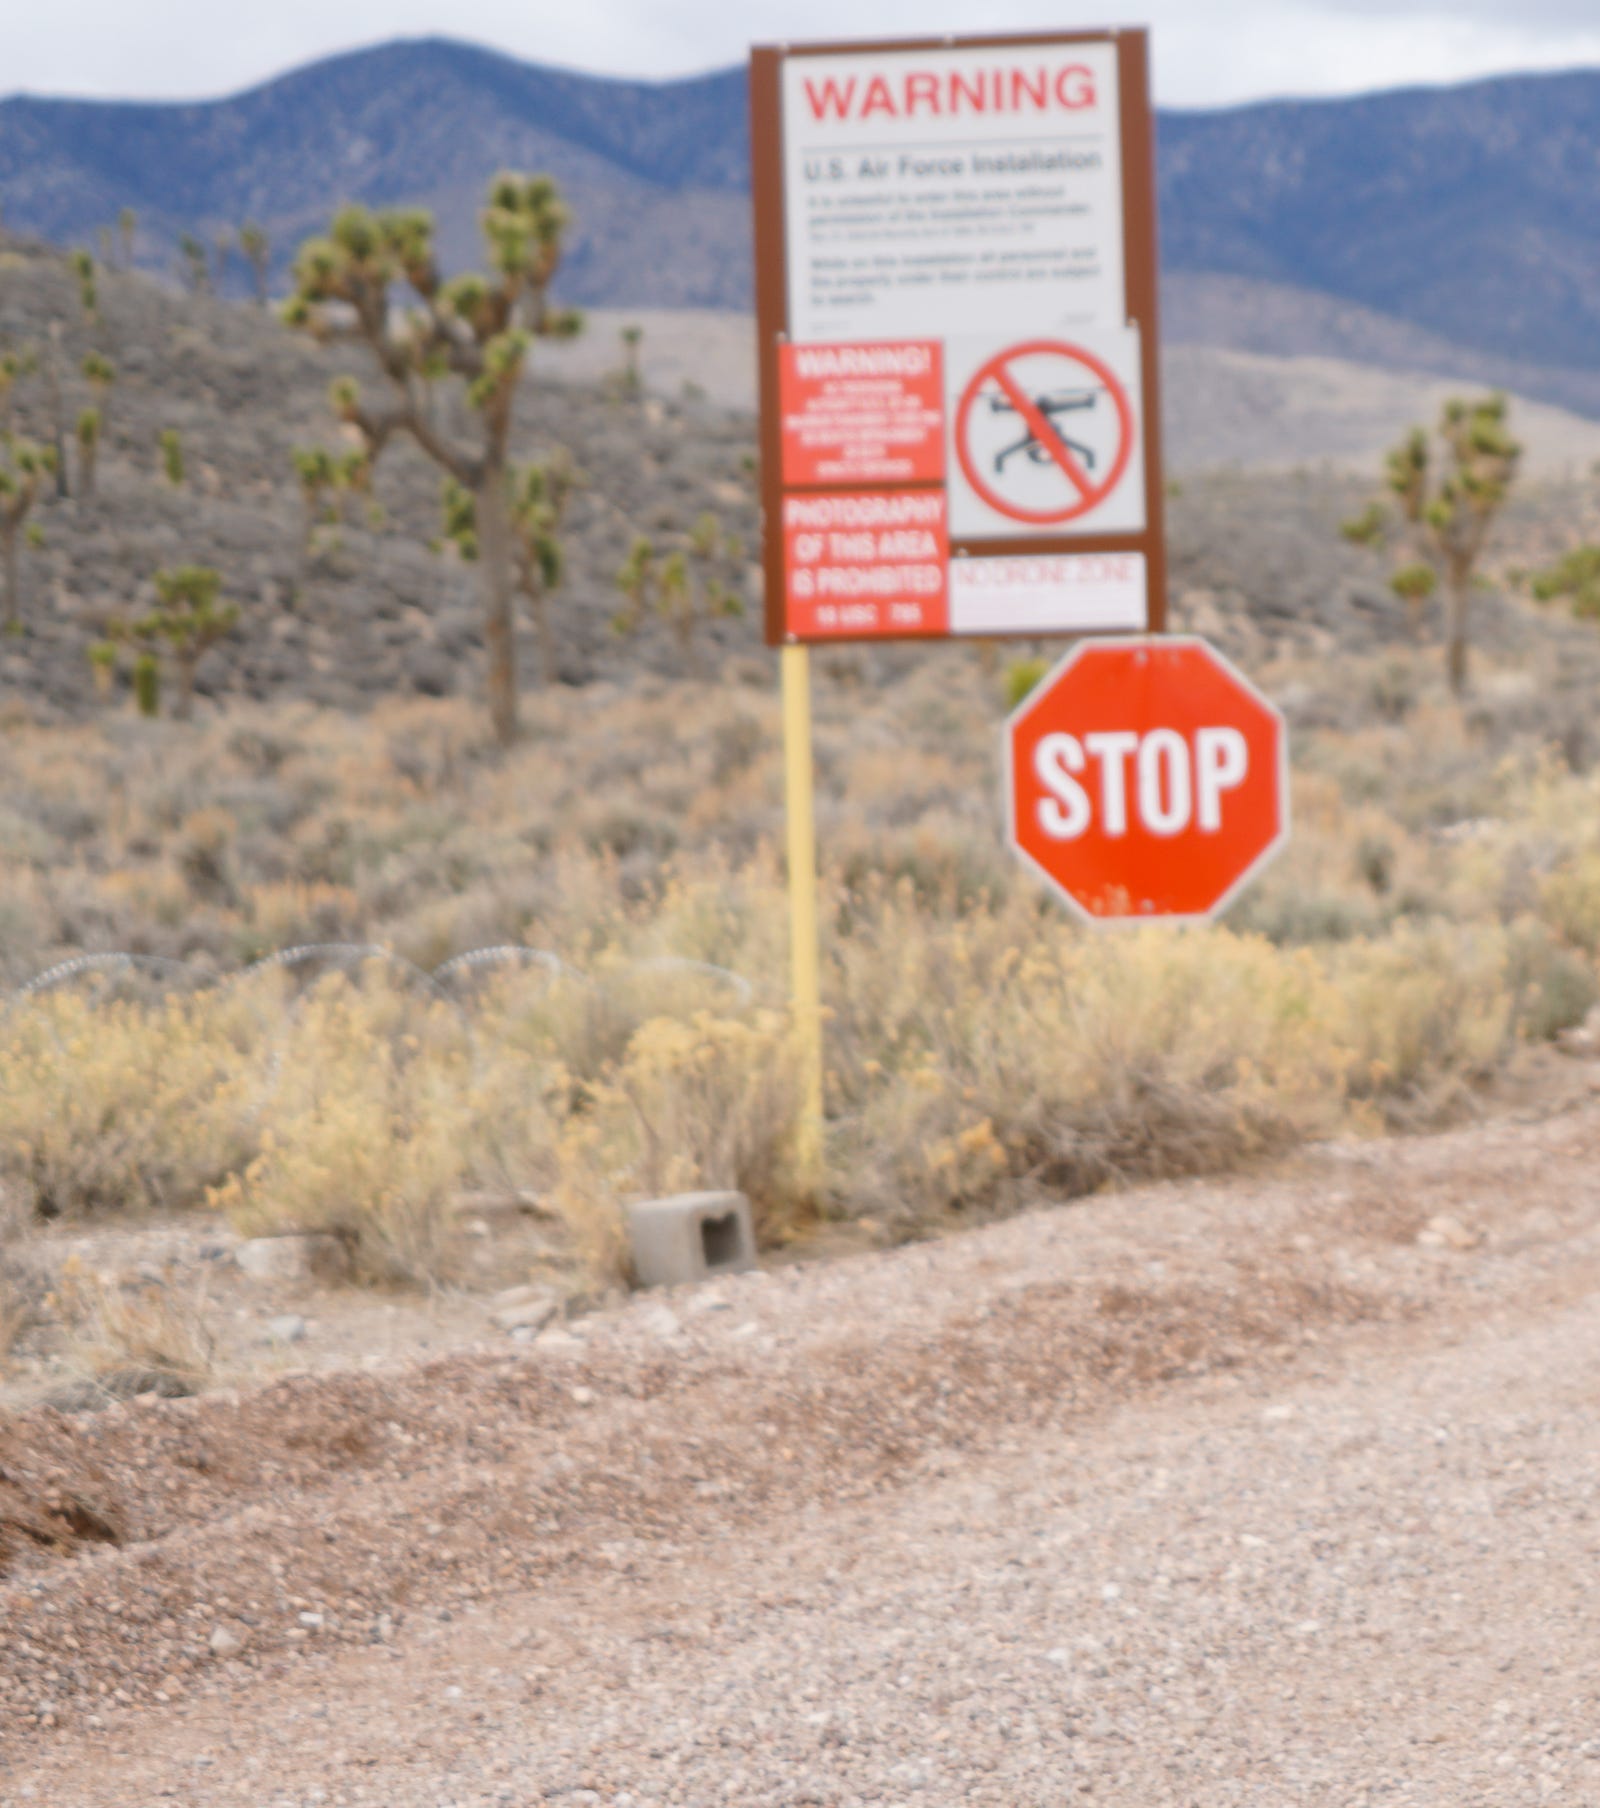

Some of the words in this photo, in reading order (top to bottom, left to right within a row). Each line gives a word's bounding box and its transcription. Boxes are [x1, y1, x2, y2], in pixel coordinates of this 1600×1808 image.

[804, 64, 1098, 121] WARNING
[804, 157, 845, 181] U.S.
[858, 154, 888, 177] Air
[899, 153, 963, 176] Force
[973, 149, 1102, 174] Installation
[797, 346, 931, 376] WARNING!
[785, 495, 943, 528] PHOTOGRAPHY
[795, 533, 822, 563] OF
[829, 531, 871, 561] THIS
[878, 529, 939, 558] AREA
[792, 568, 815, 599] IS
[817, 564, 942, 596] PROHIBITED
[1034, 726, 1248, 840] STOP
